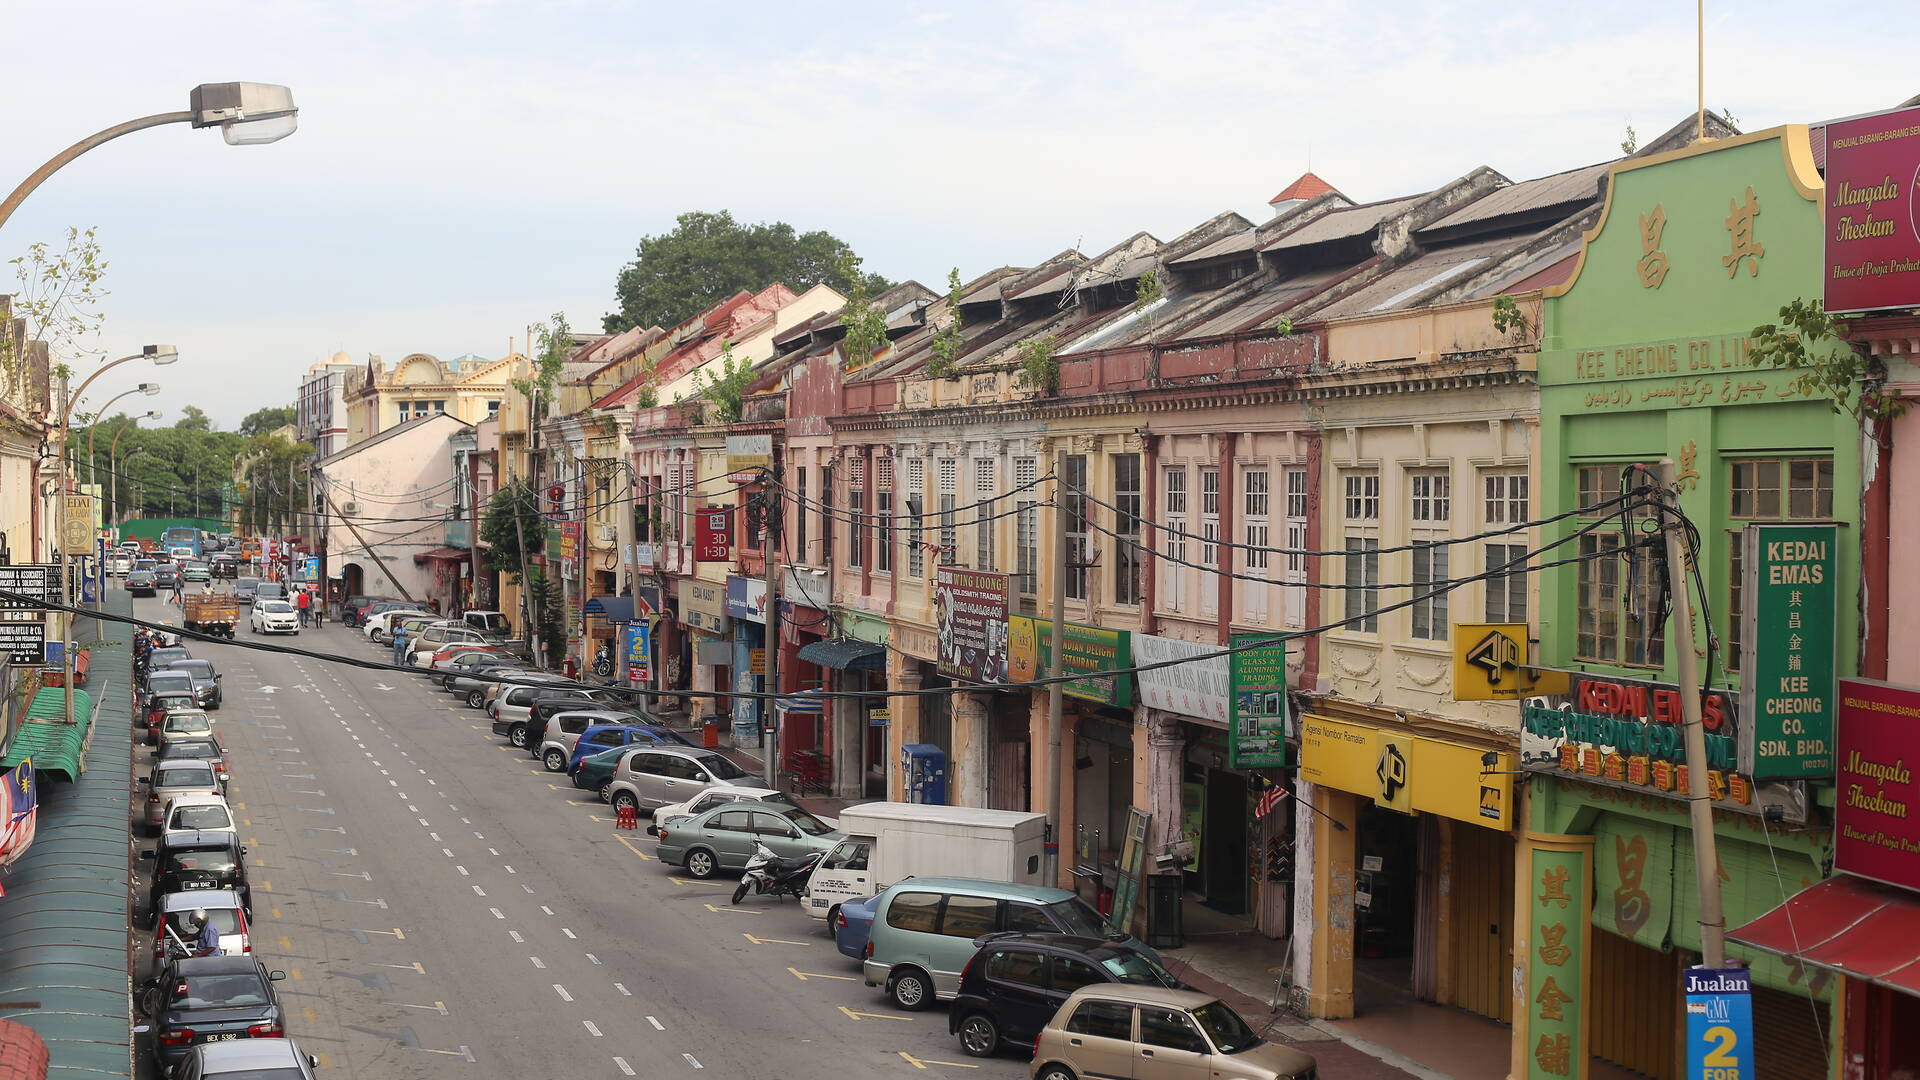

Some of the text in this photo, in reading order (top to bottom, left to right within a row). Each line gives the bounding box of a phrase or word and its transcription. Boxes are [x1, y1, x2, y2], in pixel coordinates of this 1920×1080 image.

[1832, 135, 1859, 150] MENJUAL
[1832, 175, 1899, 210] Mangala
[1835, 213, 1896, 242] Theebam
[1833, 264, 1856, 279] House
[1857, 261, 1866, 280] of
[1866, 258, 1889, 278] Pooja
[1576, 350, 1605, 379] KEE
[1615, 344, 1678, 375] CHEONG
[712, 533, 727, 544] 3D
[703, 546, 727, 557] 1+3D
[1766, 541, 1826, 562] KEDAI
[953, 573, 974, 587] WING
[975, 576, 1002, 591] LOONG
[1769, 563, 1824, 585] EMAS
[953, 588, 1002, 601] GOLDSMITH TRADING
[30, 626, 34, 635] &
[633, 636, 644, 650] 2
[1086, 644, 1116, 658] DELIGHT
[1062, 654, 1100, 671] ESTAURANT
[1780, 676, 1809, 693] KEE
[1579, 679, 1724, 731] KEDAI EMS
[1765, 698, 1822, 715] CHEONG
[1844, 697, 1871, 711] MENJUAL
[1305, 723, 1366, 745] Agensi Nombor Ramalan
[1526, 706, 1564, 739] KEE
[1566, 712, 1646, 752] CHEONG
[1782, 719, 1806, 735] CO.
[1759, 740, 1791, 757] SDN.
[1843, 750, 1911, 785] Mangala
[1846, 784, 1907, 819] Theebam
[1843, 824, 1867, 841] House
[1867, 830, 1878, 846] of
[1877, 831, 1899, 850] Pooja
[1686, 975, 1749, 992] Jualan
[206, 1034, 219, 1042] BEX
[1703, 1026, 1738, 1067] 2
[1703, 1069, 1739, 1080] FOR
